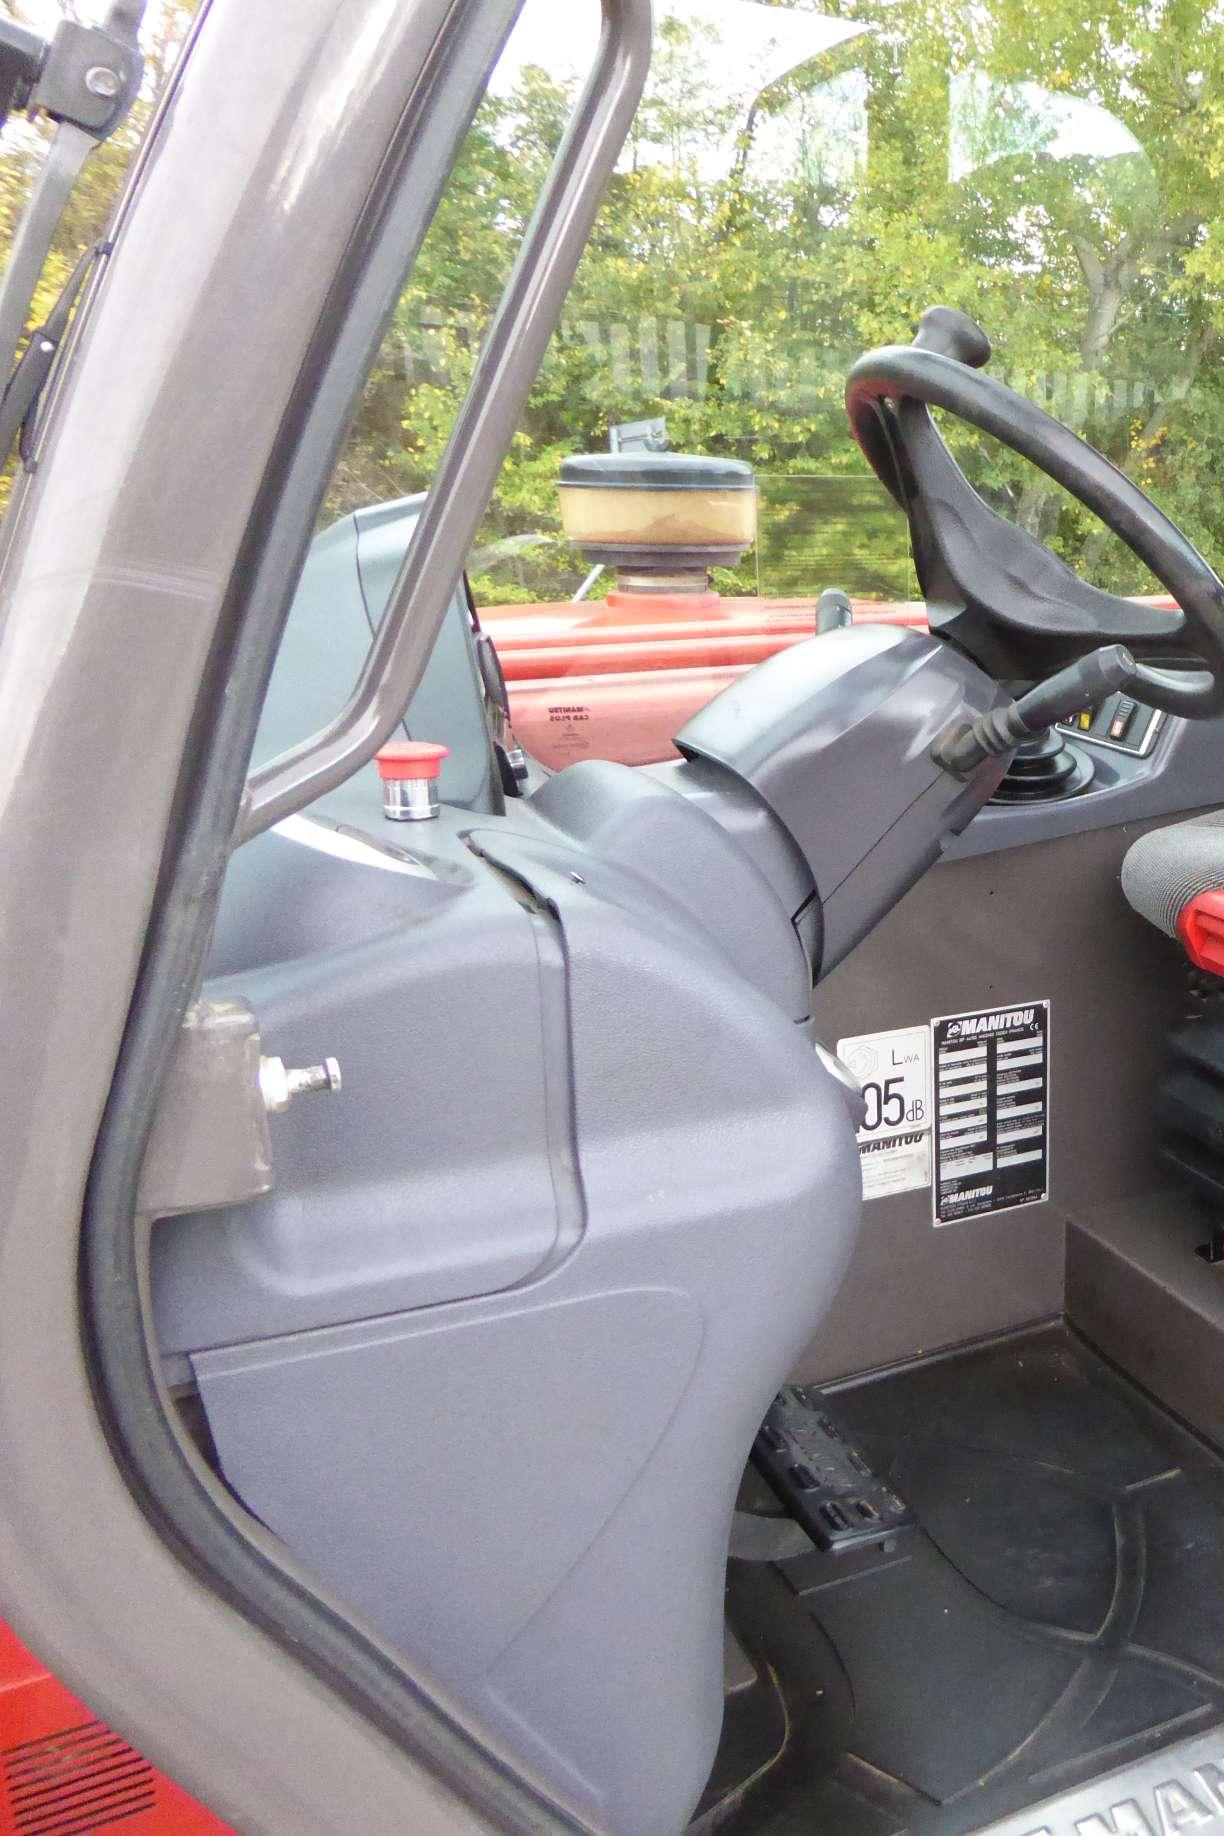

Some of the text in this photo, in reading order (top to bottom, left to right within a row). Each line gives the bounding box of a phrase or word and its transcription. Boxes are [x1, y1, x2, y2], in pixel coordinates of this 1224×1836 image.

[960, 1008, 1035, 1037] MANITOU
[856, 1076, 905, 1132] 05
[859, 1132, 925, 1155] MANITOU
[947, 1185, 993, 1204] MANITOU
